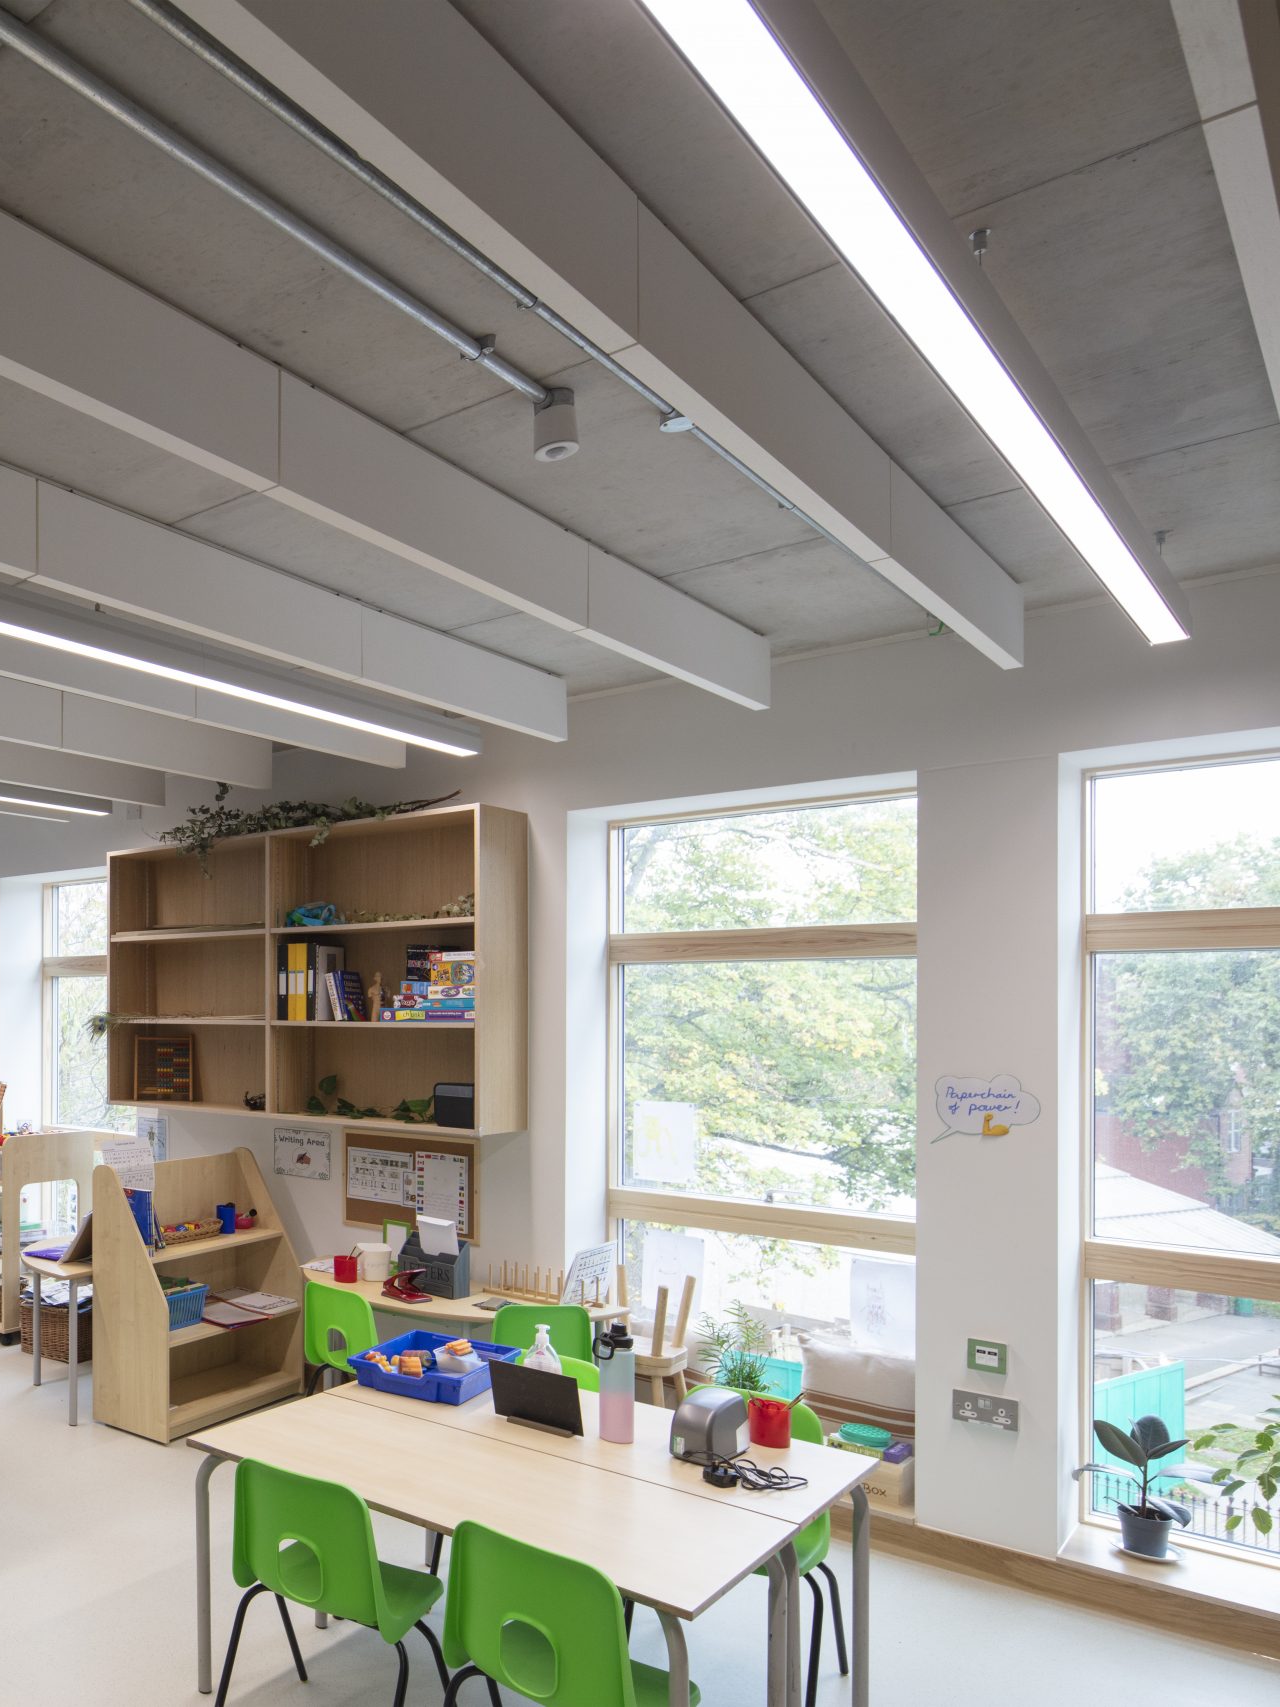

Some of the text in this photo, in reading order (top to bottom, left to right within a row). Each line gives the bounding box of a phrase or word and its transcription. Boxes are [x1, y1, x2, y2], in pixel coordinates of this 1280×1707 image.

[945, 1086, 1016, 1102] Paperchain
[948, 1100, 1020, 1116] of power!
[278, 1134, 326, 1147] Writing Area
[403, 1259, 451, 1282] LTERS
